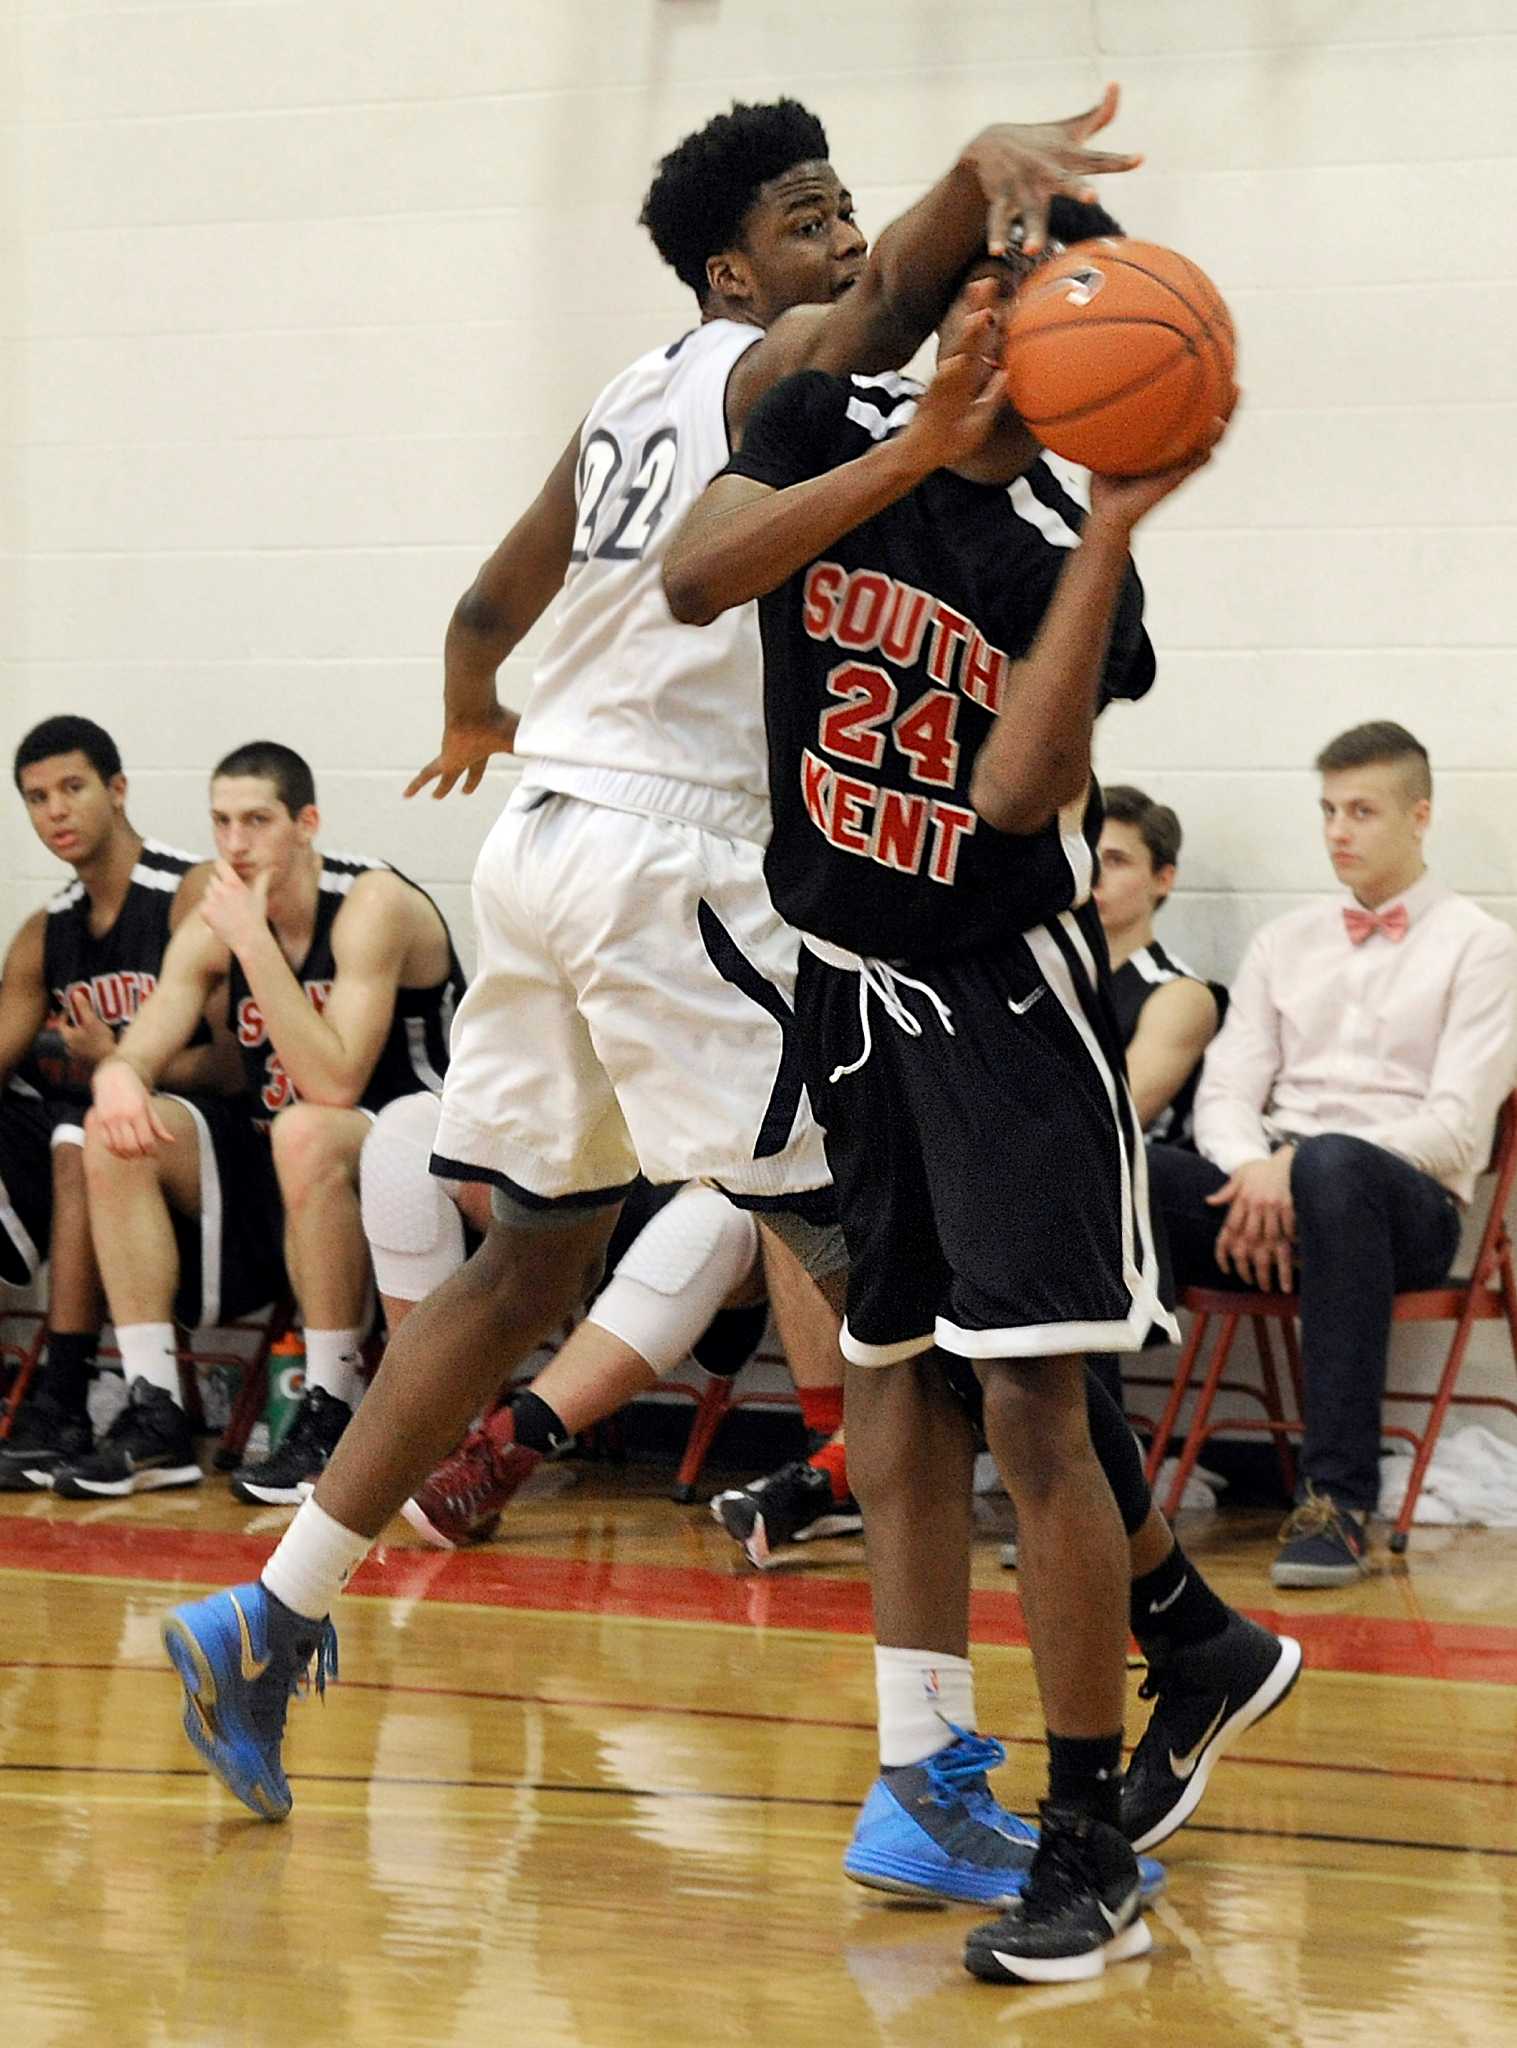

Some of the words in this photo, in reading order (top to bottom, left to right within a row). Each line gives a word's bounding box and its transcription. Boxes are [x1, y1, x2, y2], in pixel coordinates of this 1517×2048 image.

[571, 427, 678, 561] 22
[803, 560, 1008, 716] SOUTH
[819, 661, 960, 789] 24
[801, 747, 976, 885] KENT
[52, 970, 156, 1026] OUT
